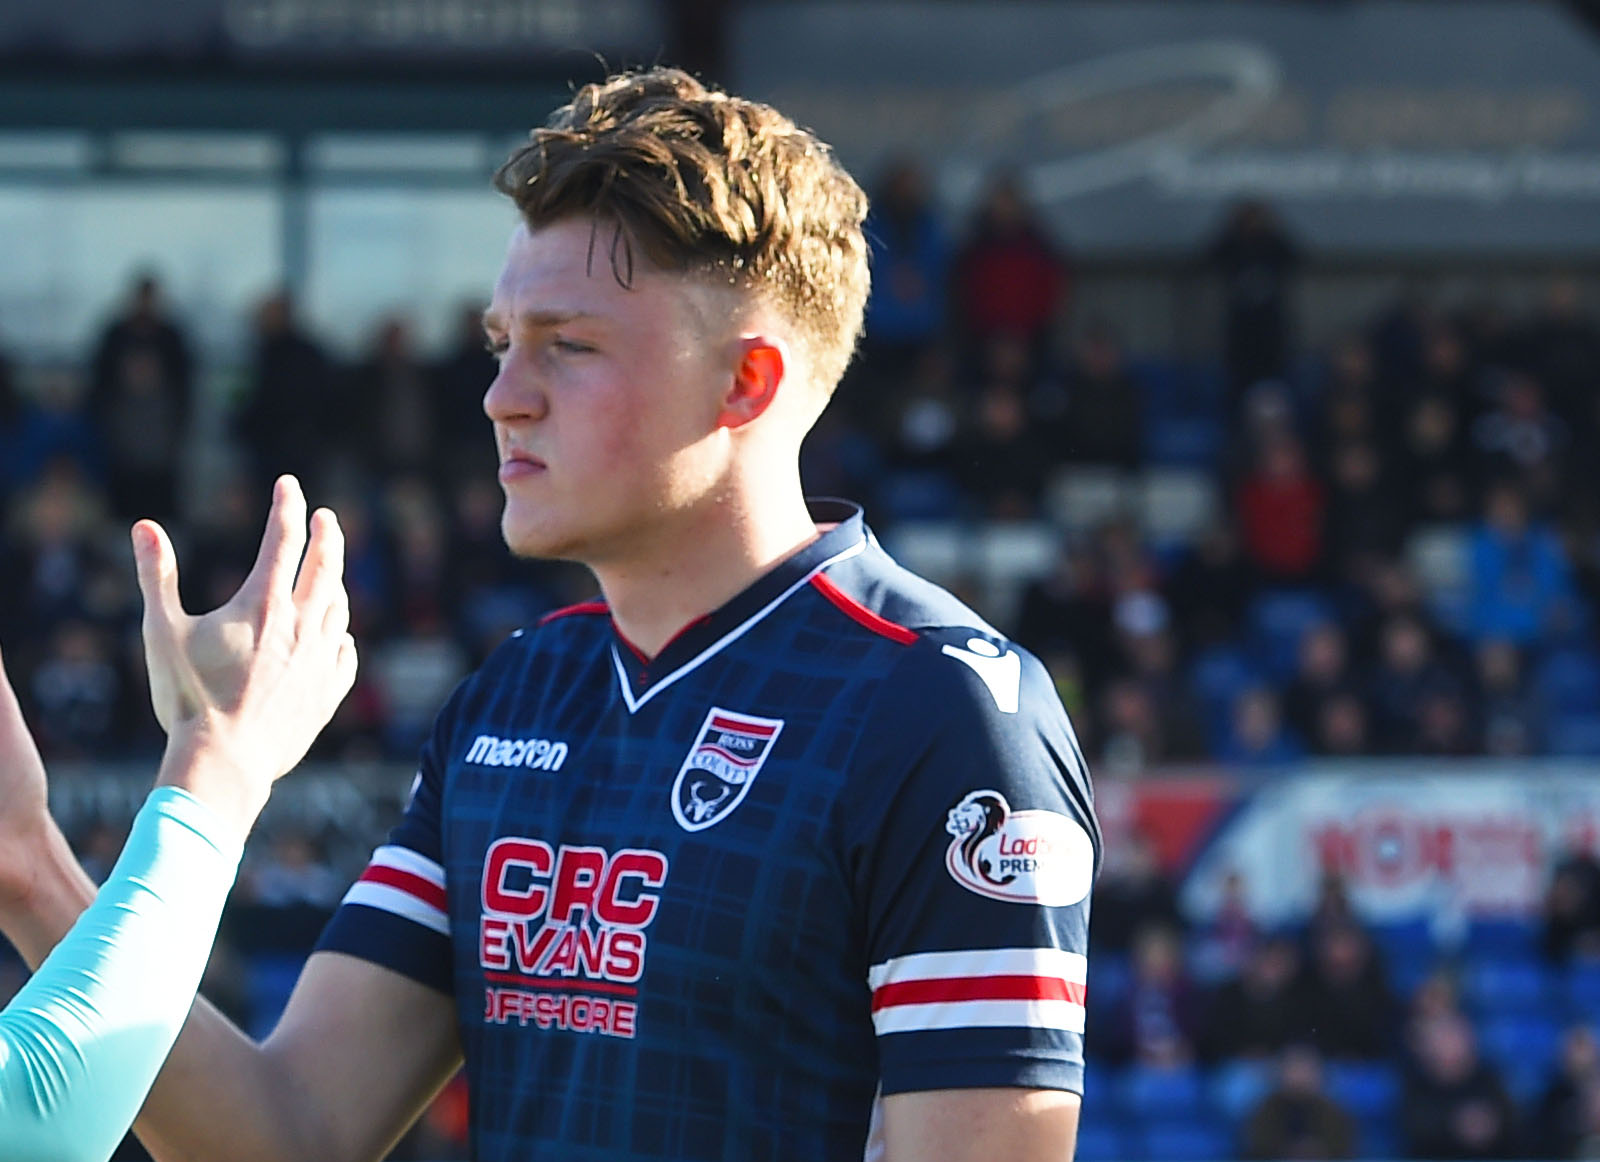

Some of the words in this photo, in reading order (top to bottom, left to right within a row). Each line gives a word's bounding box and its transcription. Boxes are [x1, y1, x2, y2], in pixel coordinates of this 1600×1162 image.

[464, 735, 569, 772] macron
[481, 836, 669, 930] CRC
[480, 913, 647, 983] EVANS
